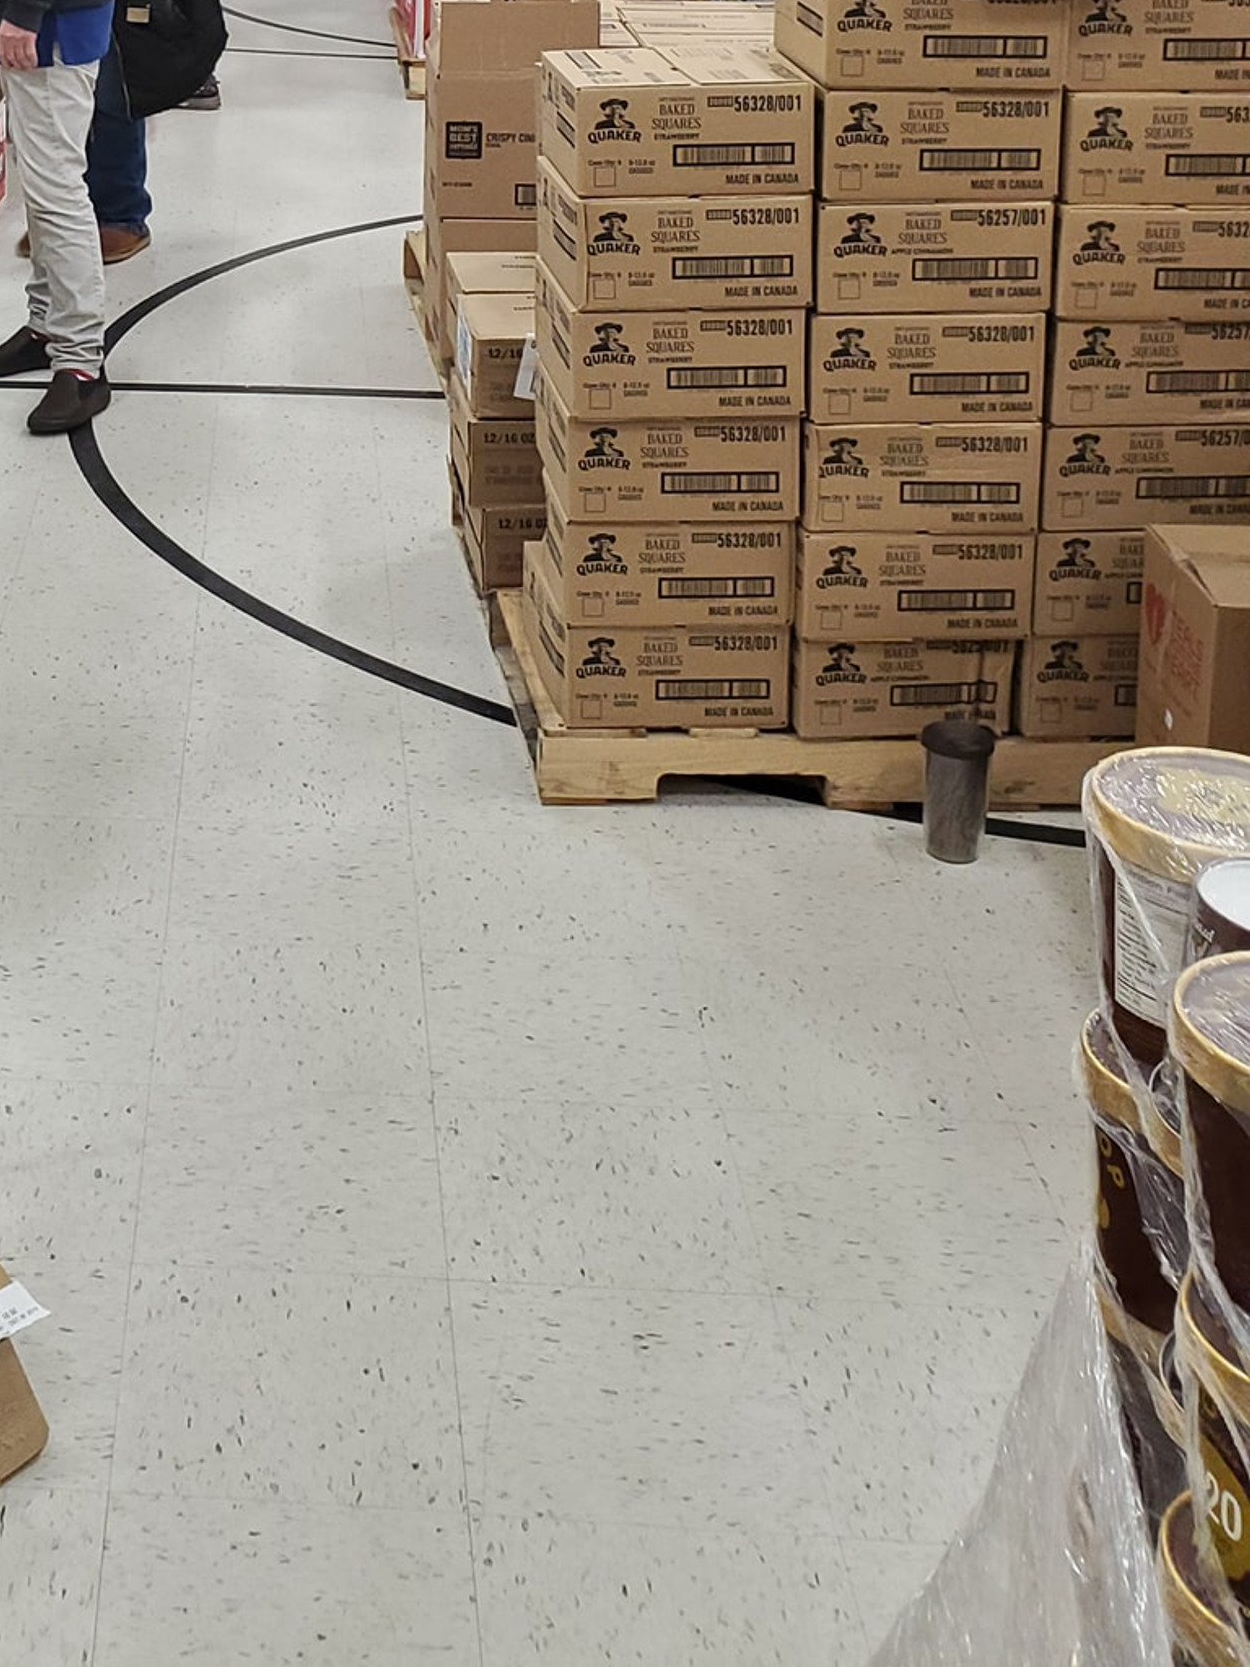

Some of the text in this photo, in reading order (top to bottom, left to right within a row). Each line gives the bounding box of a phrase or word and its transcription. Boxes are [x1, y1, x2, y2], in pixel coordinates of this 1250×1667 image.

[903, 8, 954, 21] SQUARES
[1145, 12, 1194, 24] SQUARES
[837, 18, 893, 33] QUAKER
[1079, 23, 1133, 37] QUAKER
[976, 68, 1050, 78] MADE IN CANADA
[659, 104, 695, 115] BAKED
[734, 96, 801, 112] 56328/001
[983, 102, 1049, 118] 56328/001
[908, 108, 944, 120] BAKED
[651, 118, 702, 131] SQUARES
[900, 123, 950, 135] SQUARES
[588, 131, 642, 144] QUAKER
[835, 134, 889, 147] QUAKER
[1080, 139, 1133, 152] QUAKER
[726, 174, 799, 185] MADE IN CANADA
[971, 180, 1043, 190] MADE IN CANADA
[732, 208, 799, 225] 56328/001
[978, 209, 1046, 227] 56257/001
[658, 218, 694, 229] BAKED
[906, 219, 941, 230] BAKED
[651, 231, 700, 244] SQUARES
[898, 233, 948, 246] SQUARES
[587, 243, 640, 256] QUAKER
[834, 245, 888, 258] QUAKER
[1072, 253, 1126, 265] QUAKER
[725, 286, 798, 297] MADE IN CANADA
[970, 287, 1042, 298] MADE IN CANADA
[653, 328, 688, 340] BAKED
[727, 319, 792, 336] 56328/001
[969, 326, 1034, 342] 56328/001
[895, 333, 930, 345] BAKED
[646, 341, 694, 354] SQUARES
[887, 348, 936, 359] SQUARES
[583, 354, 636, 367] QUAKER
[823, 358, 877, 372] QUAKER
[1069, 357, 1121, 371] QUAKER
[719, 396, 791, 407] MADE IN CANADA
[483, 433, 519, 444] 12/16
[648, 433, 683, 445] BAKED
[721, 426, 786, 443] 56328/001
[962, 437, 1028, 452] 56328/001
[641, 447, 689, 459] SQUARES
[578, 458, 631, 471] QUAKER
[1059, 463, 1111, 477] QUAKER
[712, 501, 783, 511] MADE IN CANADA
[645, 539, 680, 551] BAKED
[717, 532, 781, 548] 56328/001
[638, 553, 686, 565] SQUARES
[576, 563, 628, 576] QUAKER
[1049, 567, 1102, 581] QUAKER
[816, 576, 868, 589] QUAKER
[643, 642, 678, 653] BAKED
[714, 636, 778, 651] 56328/001
[636, 655, 683, 666] SQUARES
[576, 666, 626, 678] QUAKER
[816, 673, 867, 686] QUAKER
